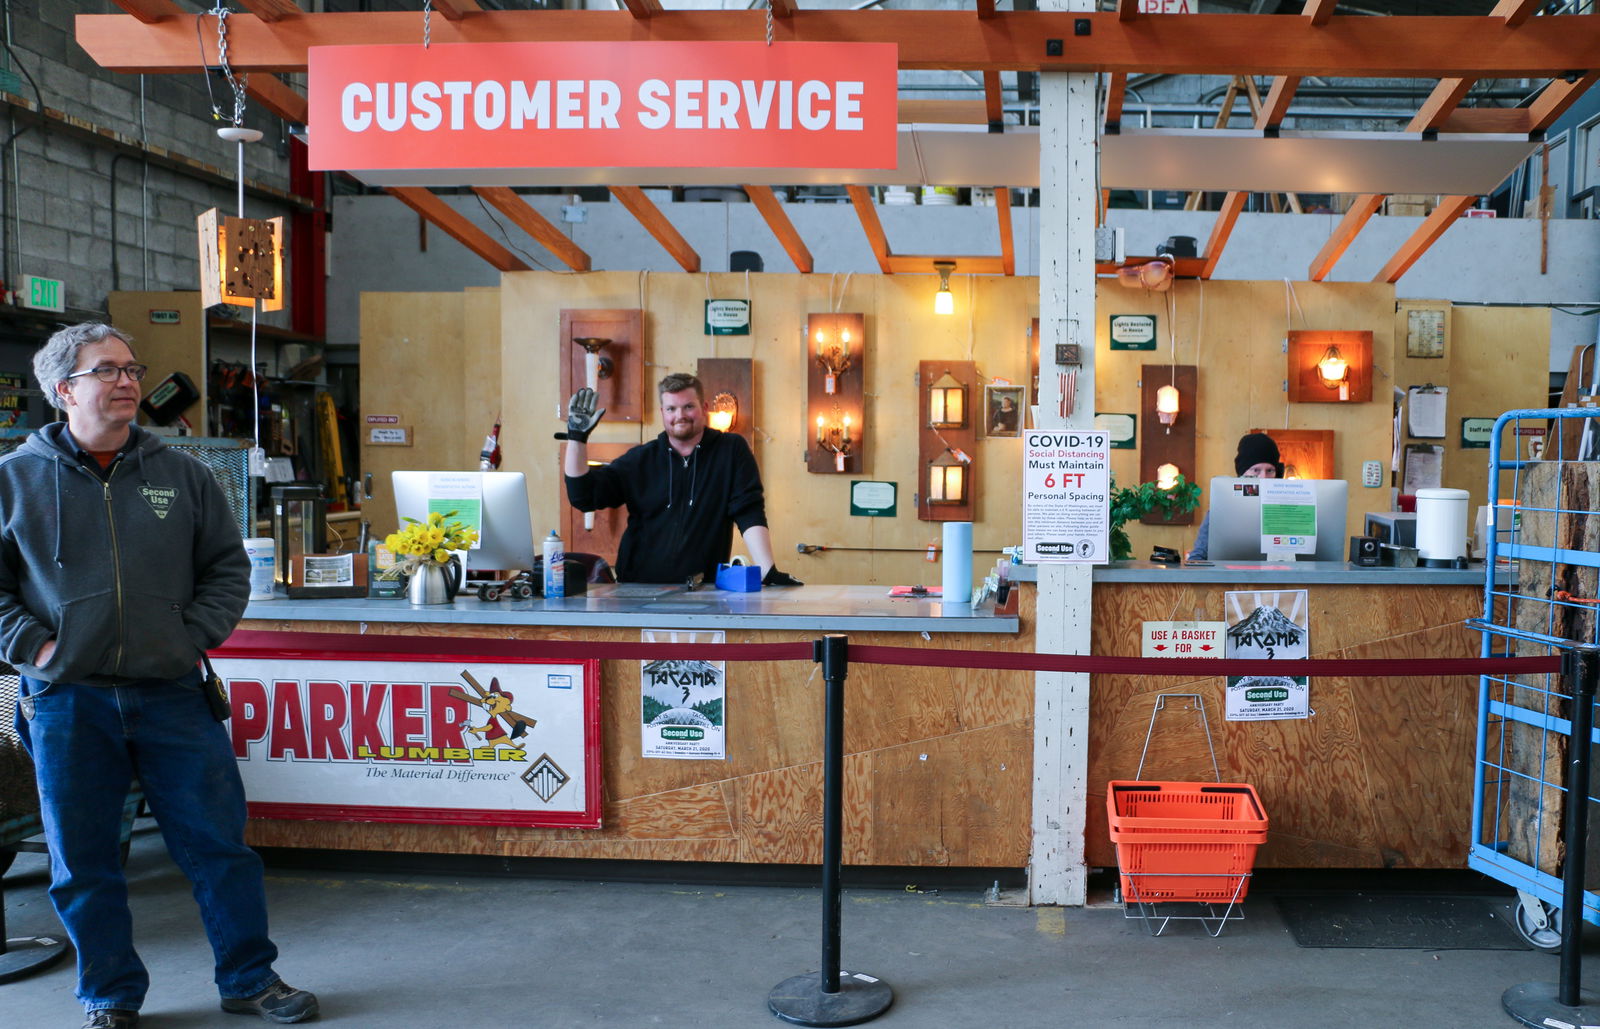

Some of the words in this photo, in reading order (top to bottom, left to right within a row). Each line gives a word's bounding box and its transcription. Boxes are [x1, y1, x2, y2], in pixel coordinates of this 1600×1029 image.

[341, 80, 622, 132] CUSTOMER
[637, 79, 864, 131] SERVICE
[31, 277, 59, 308] EXIT
[1029, 435, 1104, 448] COVID-19
[1029, 449, 1055, 458] Social
[1058, 449, 1105, 461] Distancing
[1028, 460, 1055, 470] Must
[1058, 460, 1104, 470] Maintain
[1044, 473, 1056, 488] 6
[1063, 473, 1086, 488] FT
[142, 488, 175, 497] Second
[1028, 492, 1067, 500] Personal
[1069, 492, 1104, 502] Spacing
[151, 496, 169, 504] Use
[1037, 544, 1060, 552] Second
[1061, 544, 1073, 552] Use
[1151, 630, 1168, 640] USE
[1172, 630, 1178, 640] A
[1181, 630, 1217, 640] BASKET
[1232, 631, 1300, 650] TACOMA
[1175, 643, 1192, 653] FOR
[648, 670, 717, 688] TACOMA
[681, 686, 691, 704] 3
[1247, 690, 1273, 699] Second
[1274, 690, 1288, 698] Use
[228, 678, 474, 766] PARKER
[662, 729, 688, 737] Second
[689, 729, 703, 738] Use
[357, 745, 528, 763] LUMBER
[366, 766, 390, 779] The
[393, 767, 443, 781] Material
